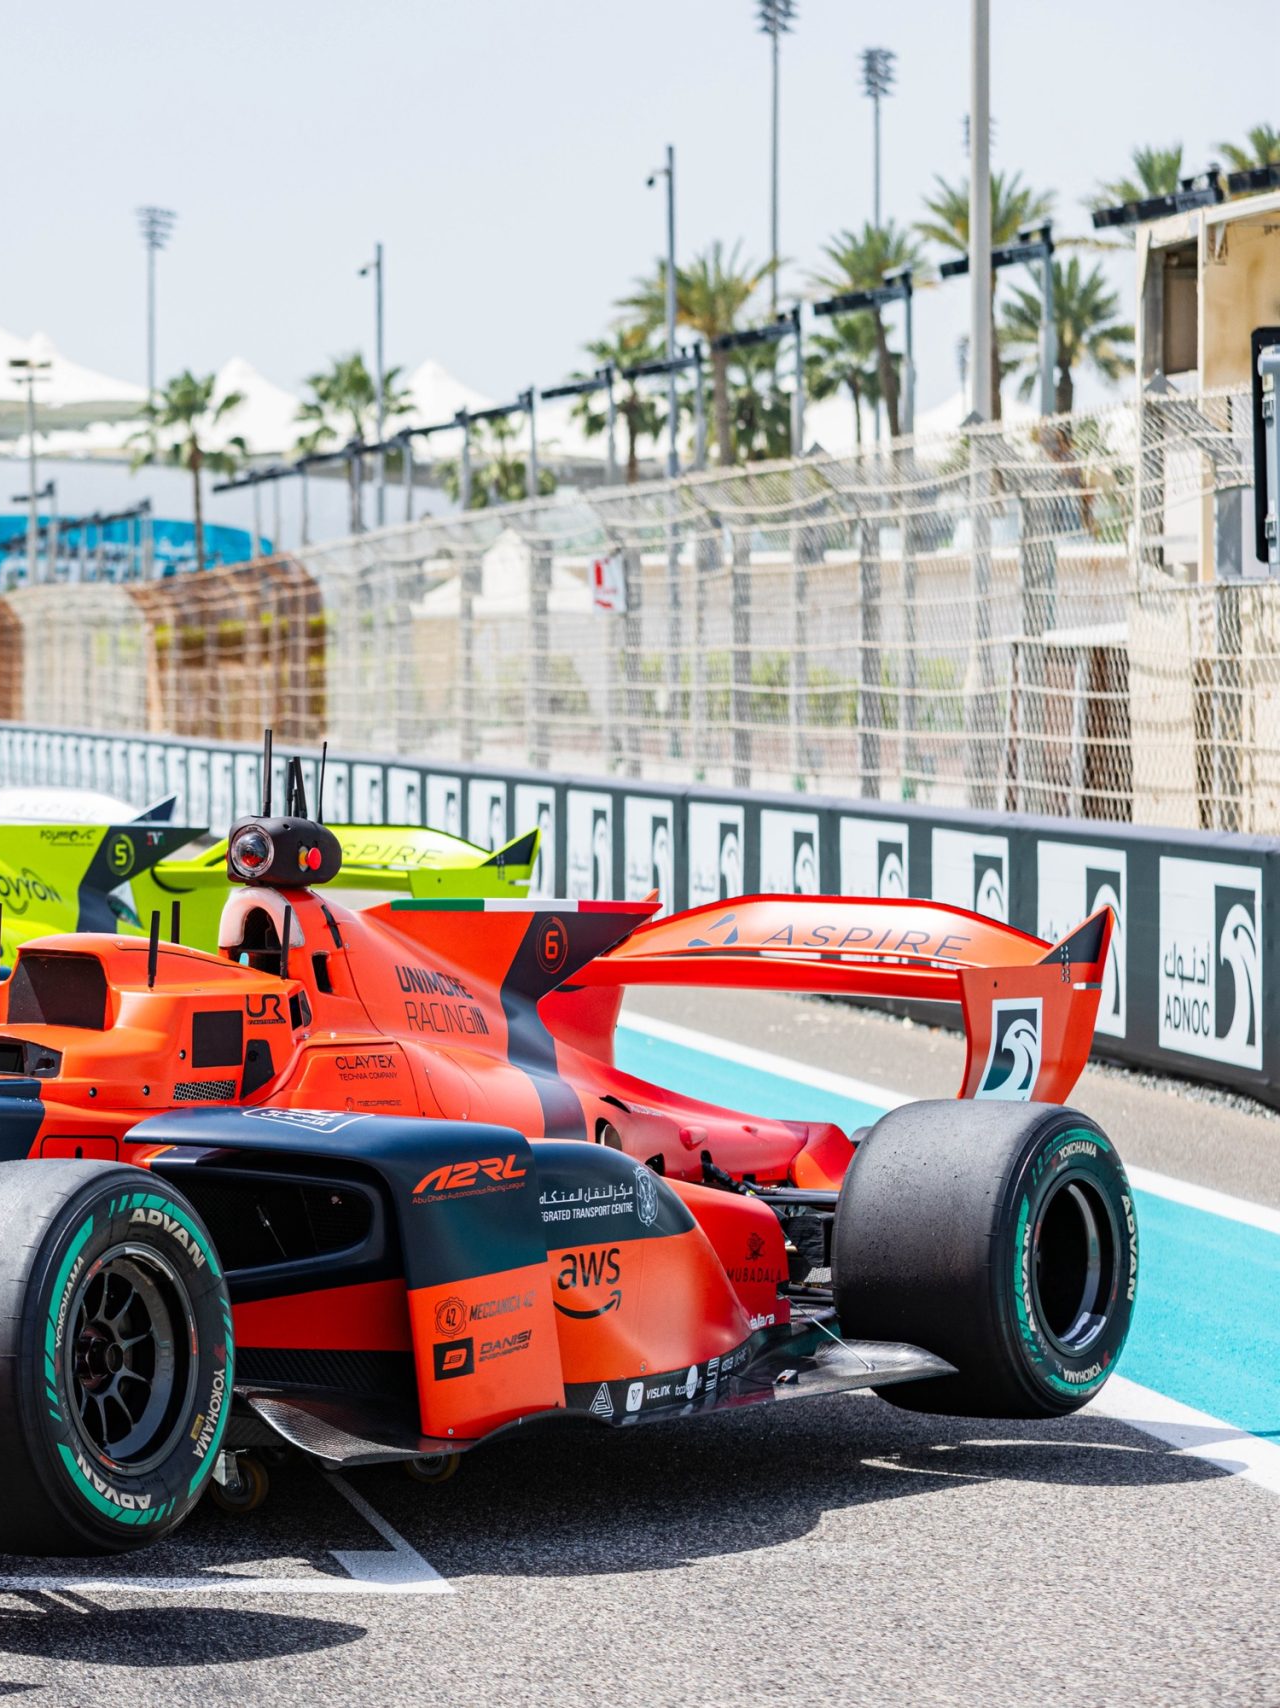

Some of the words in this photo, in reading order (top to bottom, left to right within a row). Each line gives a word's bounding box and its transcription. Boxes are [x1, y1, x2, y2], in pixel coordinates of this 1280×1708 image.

[114, 843, 127, 866] 5
[341, 843, 444, 865] SPIRE
[545, 930, 559, 959] 6
[761, 923, 972, 960] ASPIRE
[395, 965, 474, 999] UNIMORE
[404, 1001, 476, 1034] RACING
[1164, 993, 1210, 1037] ADNOC
[335, 1055, 396, 1070] CLAYTEX
[368, 1072, 398, 1080] COMPANY
[1058, 1144, 1097, 1158] YOKOHAMA
[412, 1154, 527, 1194] A2RL
[412, 1197, 427, 1205] Abu
[427, 1194, 447, 1203] Dhabi
[447, 1187, 487, 1199] Autonomous
[487, 1184, 507, 1193] Racing
[572, 1202, 610, 1219] TRANSPORT
[611, 1201, 634, 1215] CENTRE
[128, 1208, 206, 1269] ADVAN
[1121, 1195, 1137, 1301] ADVAN
[557, 1248, 620, 1290] aws
[726, 1267, 783, 1283] MUBADALA
[1022, 1223, 1037, 1332] ADVAN
[55, 1255, 85, 1348] YOKOHAMA
[446, 1308, 457, 1327] 42
[480, 1329, 532, 1354] DANISI
[1063, 1362, 1102, 1384] YOKOHAMA
[646, 1385, 671, 1399] VISLINK
[192, 1369, 225, 1459] YOKOHAMA
[77, 1454, 151, 1510] ADVAN
